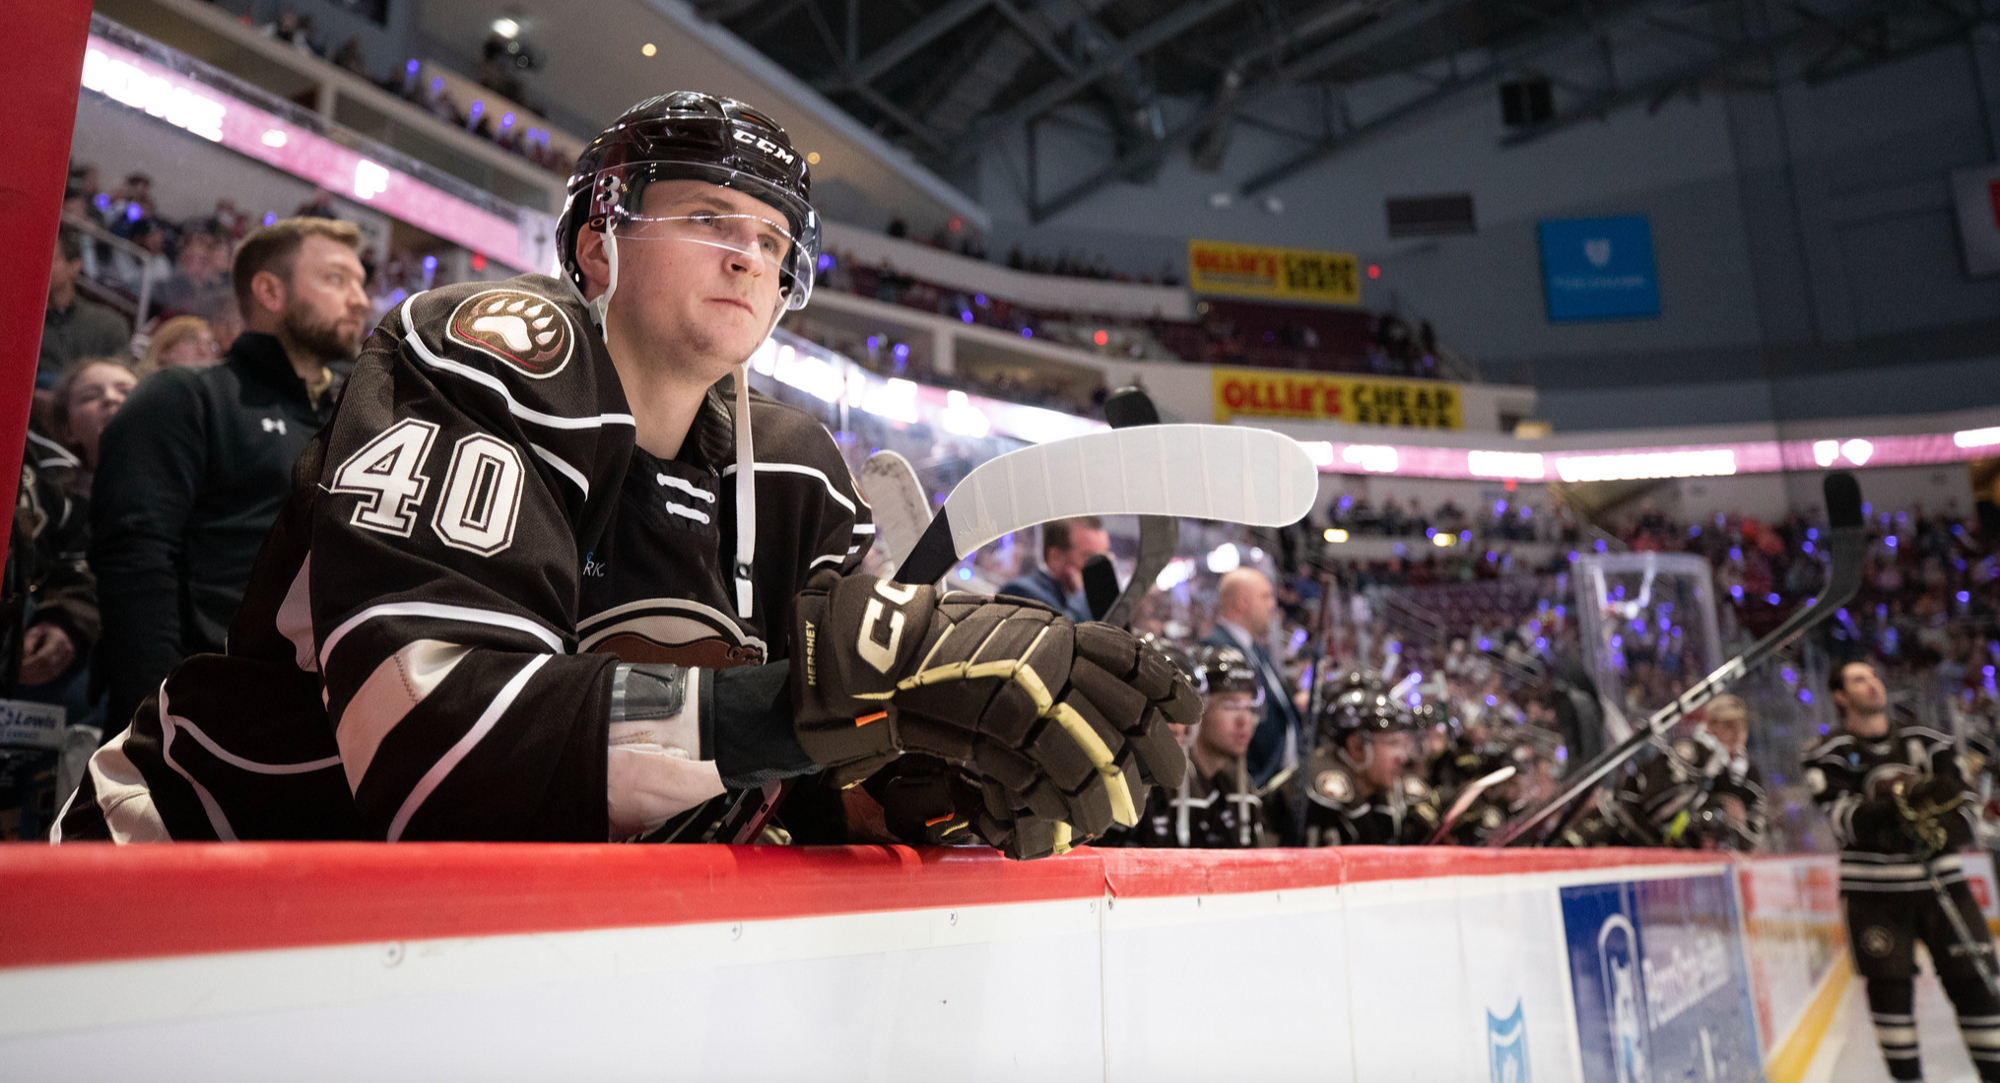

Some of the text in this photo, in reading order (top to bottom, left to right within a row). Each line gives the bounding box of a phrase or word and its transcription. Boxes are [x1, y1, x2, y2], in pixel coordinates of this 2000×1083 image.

[733, 129, 794, 164] CCM
[1352, 383, 1453, 410] CHEAP
[328, 417, 526, 558] 40
[805, 619, 817, 686] HERSHEY
